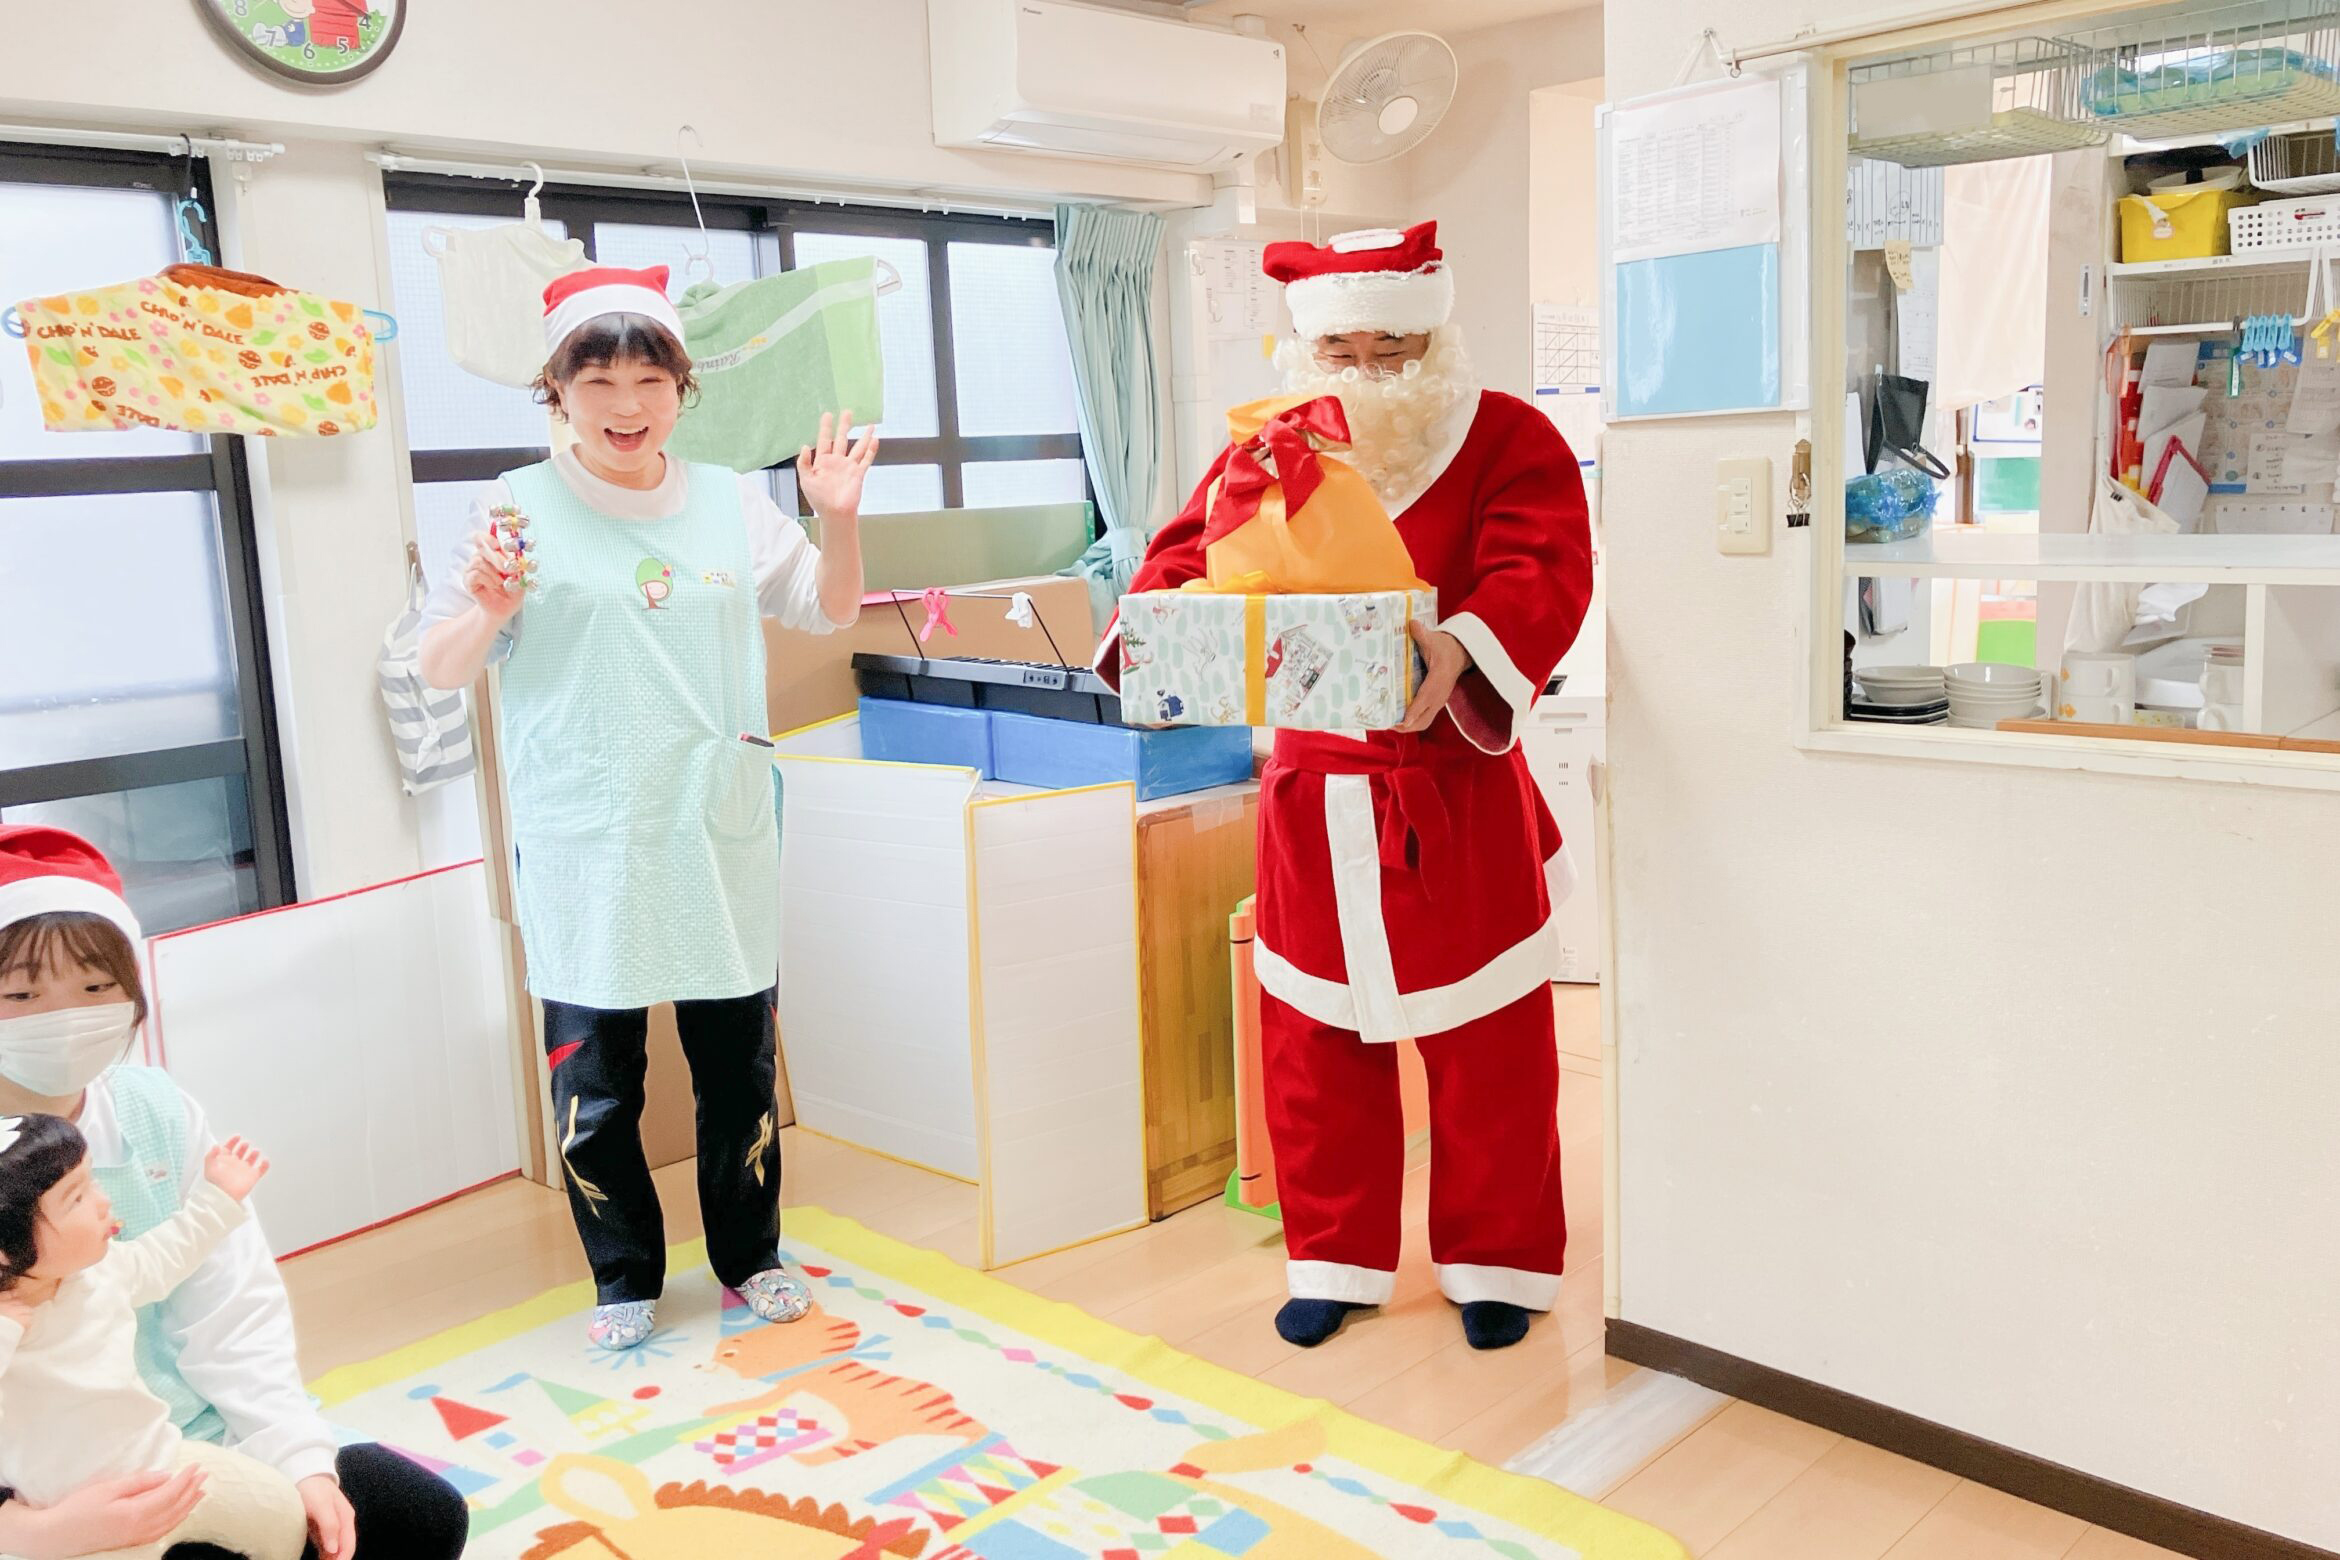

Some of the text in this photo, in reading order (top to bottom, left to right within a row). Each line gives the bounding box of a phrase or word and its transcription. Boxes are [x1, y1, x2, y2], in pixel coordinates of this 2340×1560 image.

[235, 0, 247, 16] 8
[358, 14, 371, 30] 4
[264, 30, 277, 47] 7
[337, 38, 349, 54] 5
[304, 43, 316, 60] 6
[96, 326, 142, 341] DALE
[202, 323, 244, 345] DALE
[250, 373, 292, 388] DALE
[116, 405, 160, 427] DALE
